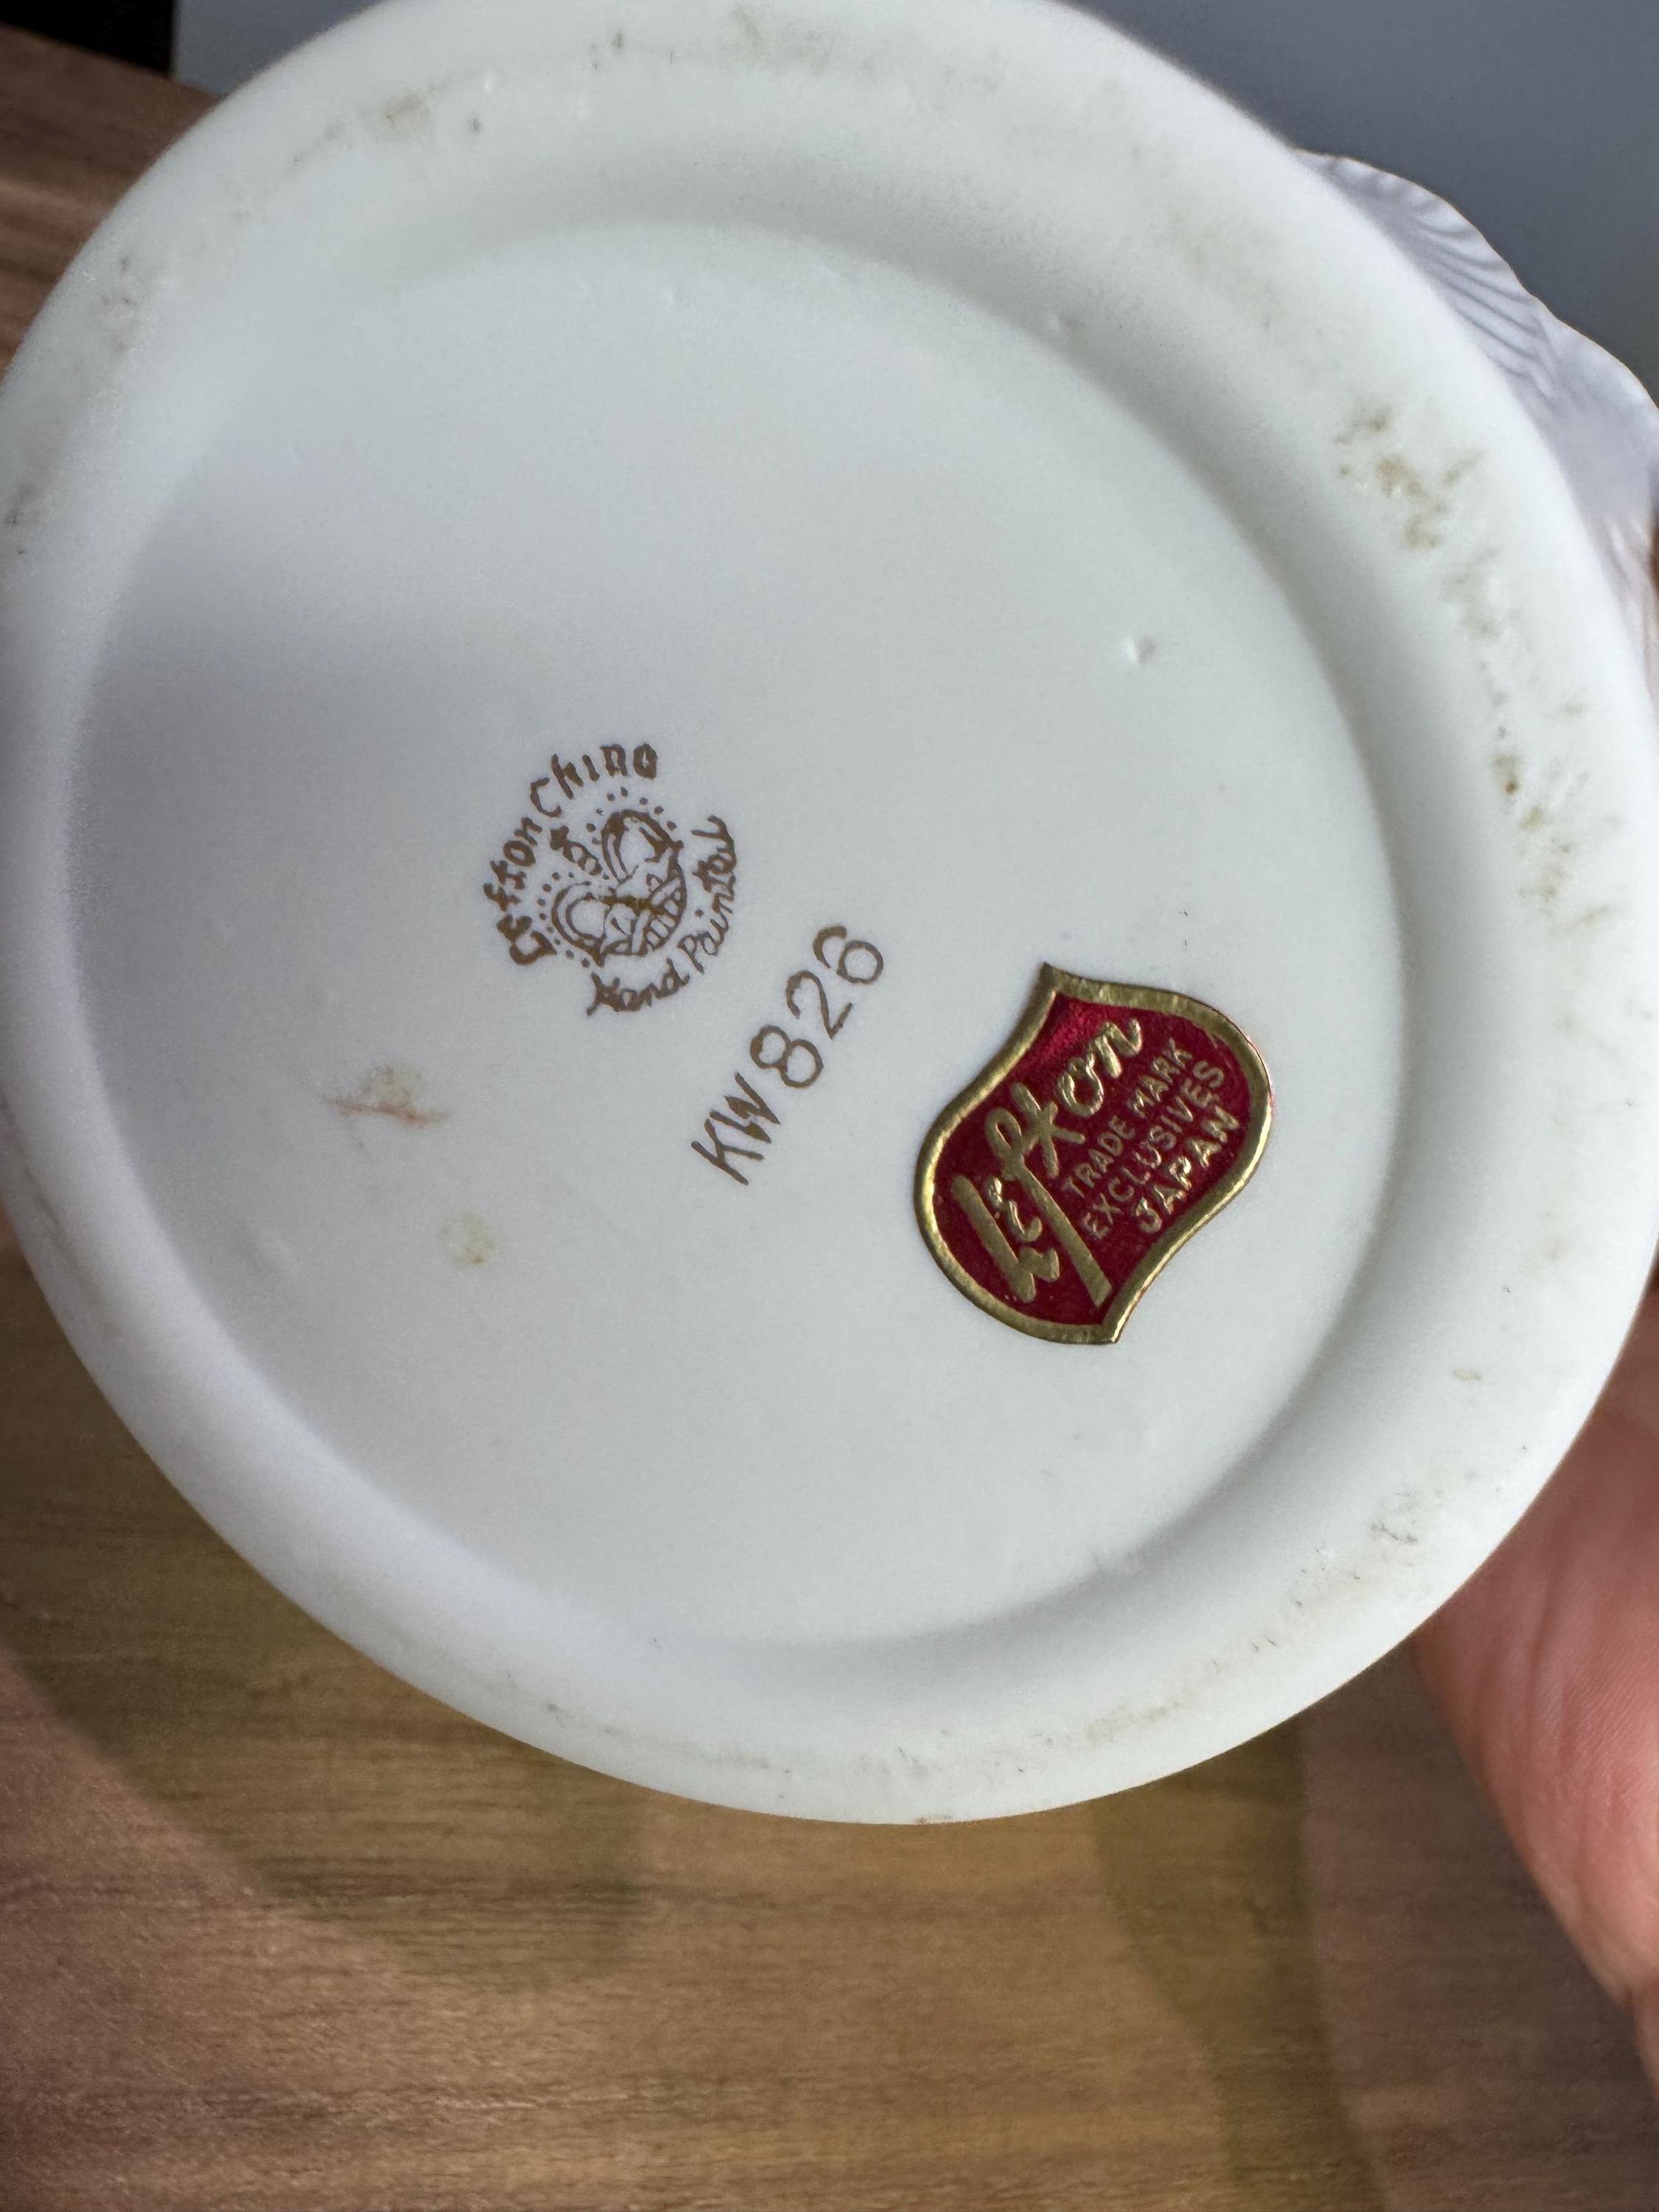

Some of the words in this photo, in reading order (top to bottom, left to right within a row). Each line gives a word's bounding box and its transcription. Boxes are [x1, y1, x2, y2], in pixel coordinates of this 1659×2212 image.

[587, 956, 691, 1016] Hand
[677, 815, 737, 974] Painted
[950, 1018, 1143, 1308] Lefton
[1062, 1115, 1135, 1198] TRADE
[1125, 1037, 1194, 1119] MARK
[1080, 1060, 1225, 1239] EXCLUSIVES
[1134, 1105, 1240, 1234] JAPAN
